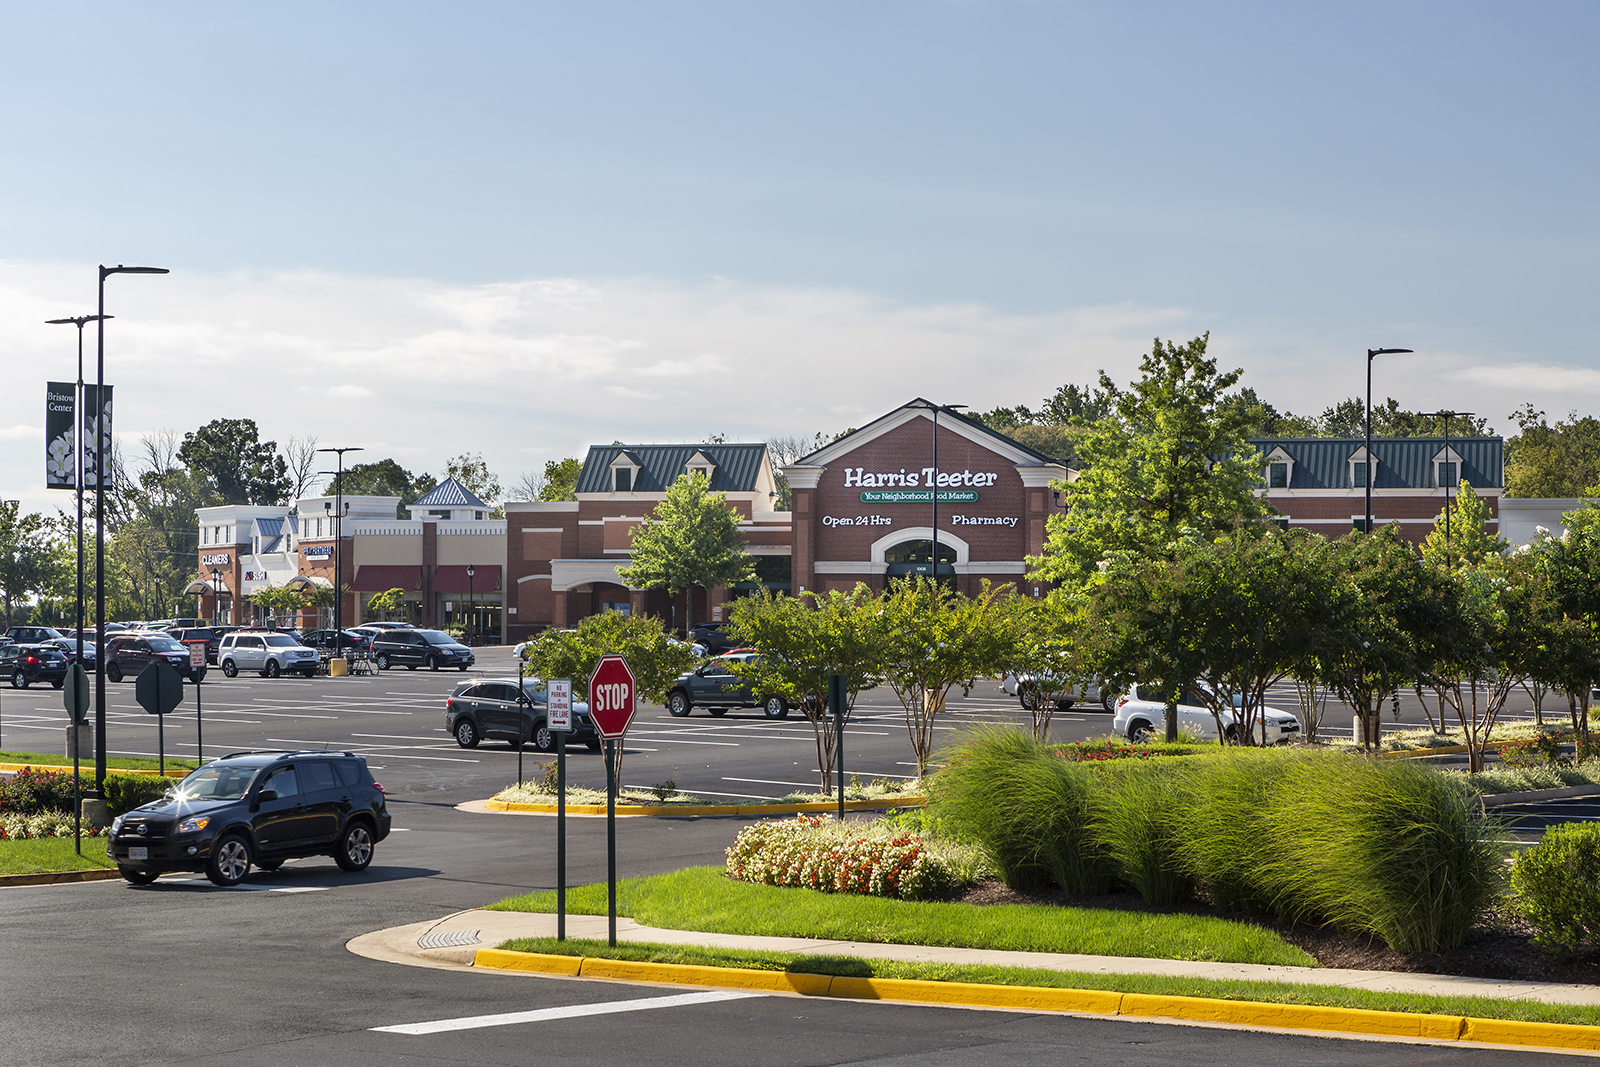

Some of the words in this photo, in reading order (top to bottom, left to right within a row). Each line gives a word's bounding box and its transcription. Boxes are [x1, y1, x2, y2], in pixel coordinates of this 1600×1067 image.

[47, 392, 74, 401] Bristow
[48, 402, 72, 412] Center
[844, 467, 919, 488] Harris
[921, 467, 998, 488] Teeter
[864, 492, 881, 500] Your
[881, 492, 929, 502] Neighborhood
[948, 492, 974, 500] Market
[822, 516, 854, 528] Open
[855, 515, 869, 526] 24
[870, 515, 892, 526] Hrs
[952, 515, 1019, 528] Pharmacy
[202, 553, 229, 565] CLEANERS
[596, 683, 629, 711] STOP
[549, 710, 558, 718] FIRE
[559, 710, 569, 718] LANE
